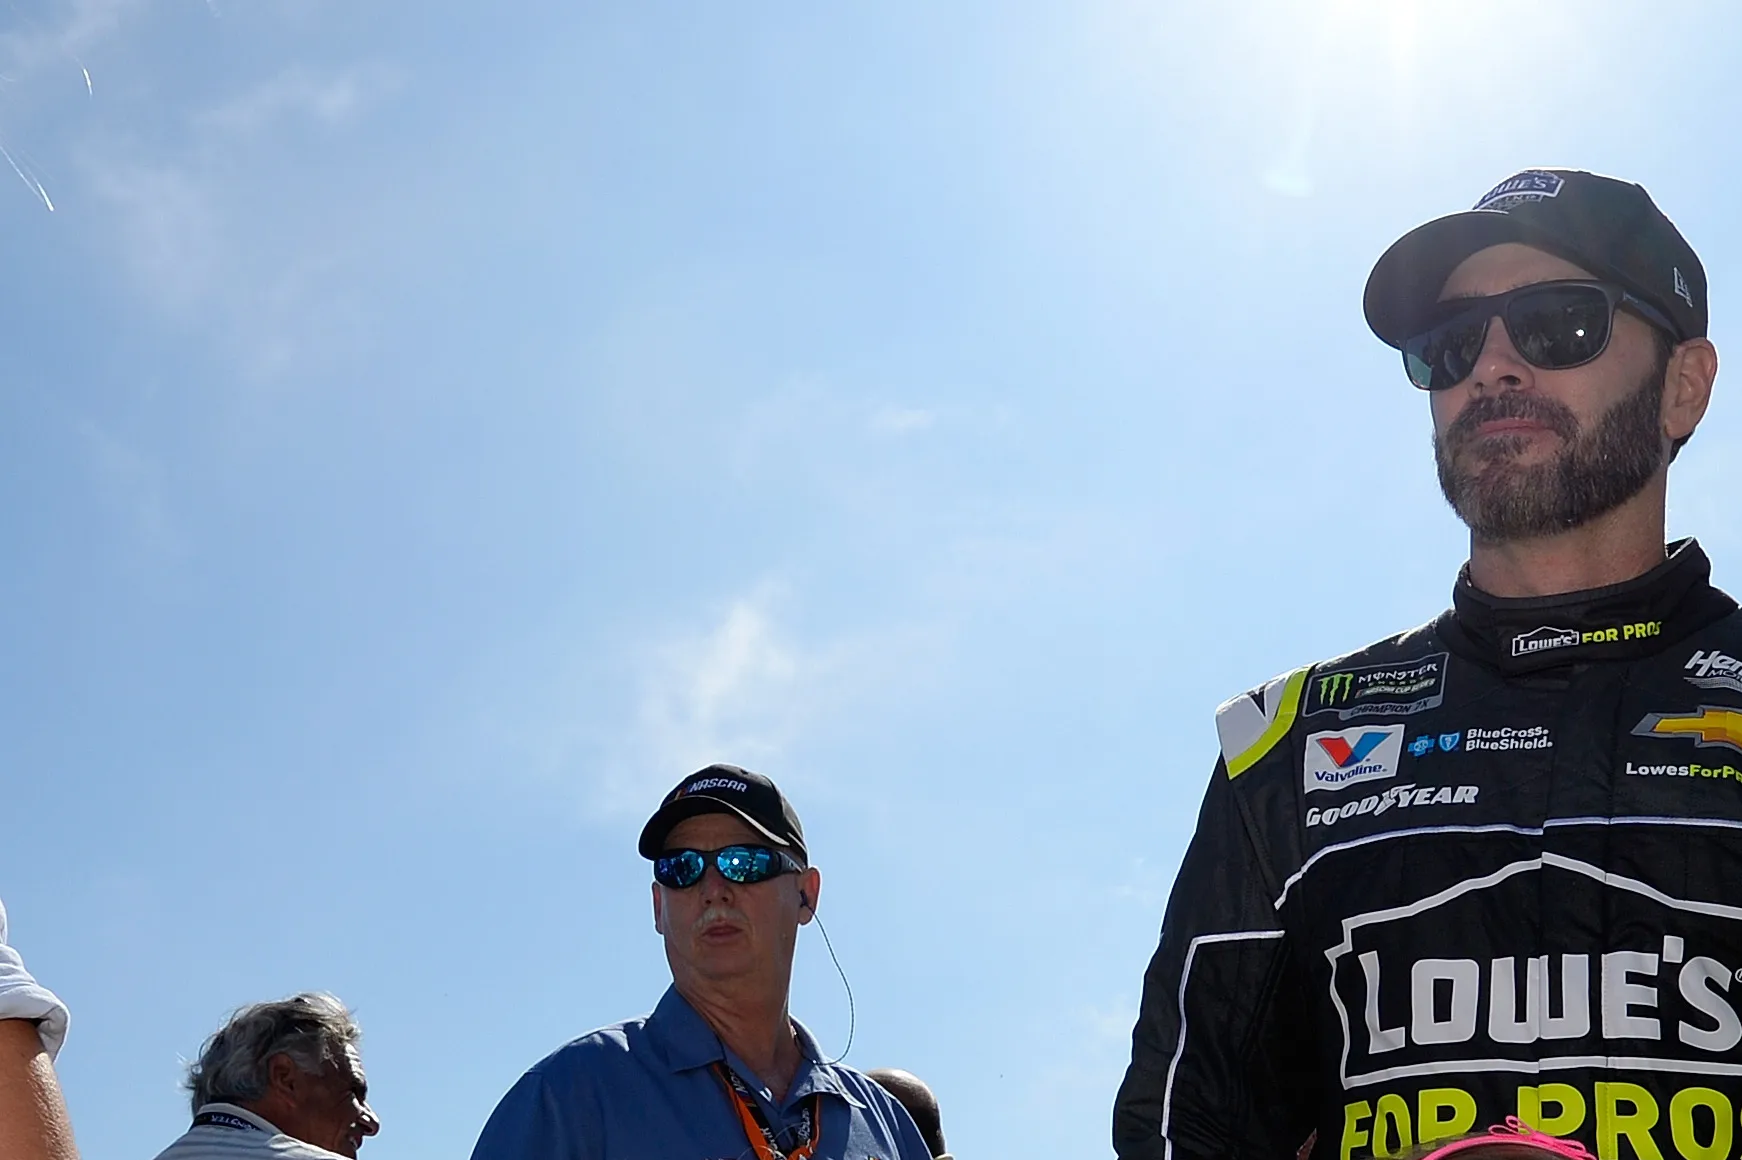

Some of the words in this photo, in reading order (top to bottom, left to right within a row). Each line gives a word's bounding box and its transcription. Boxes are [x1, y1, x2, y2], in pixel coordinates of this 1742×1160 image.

[1518, 634, 1573, 652] LOWE'S
[1582, 628, 1618, 644] FOR
[1623, 621, 1662, 640] PROS
[1351, 704, 1410, 715] CHAMPION
[1466, 727, 1542, 740] BlueCross
[1465, 736, 1547, 752] BlueShield
[1314, 763, 1382, 782] Valvoline
[690, 778, 747, 792] NASCAR
[1306, 783, 1479, 828] GOODYEAR
